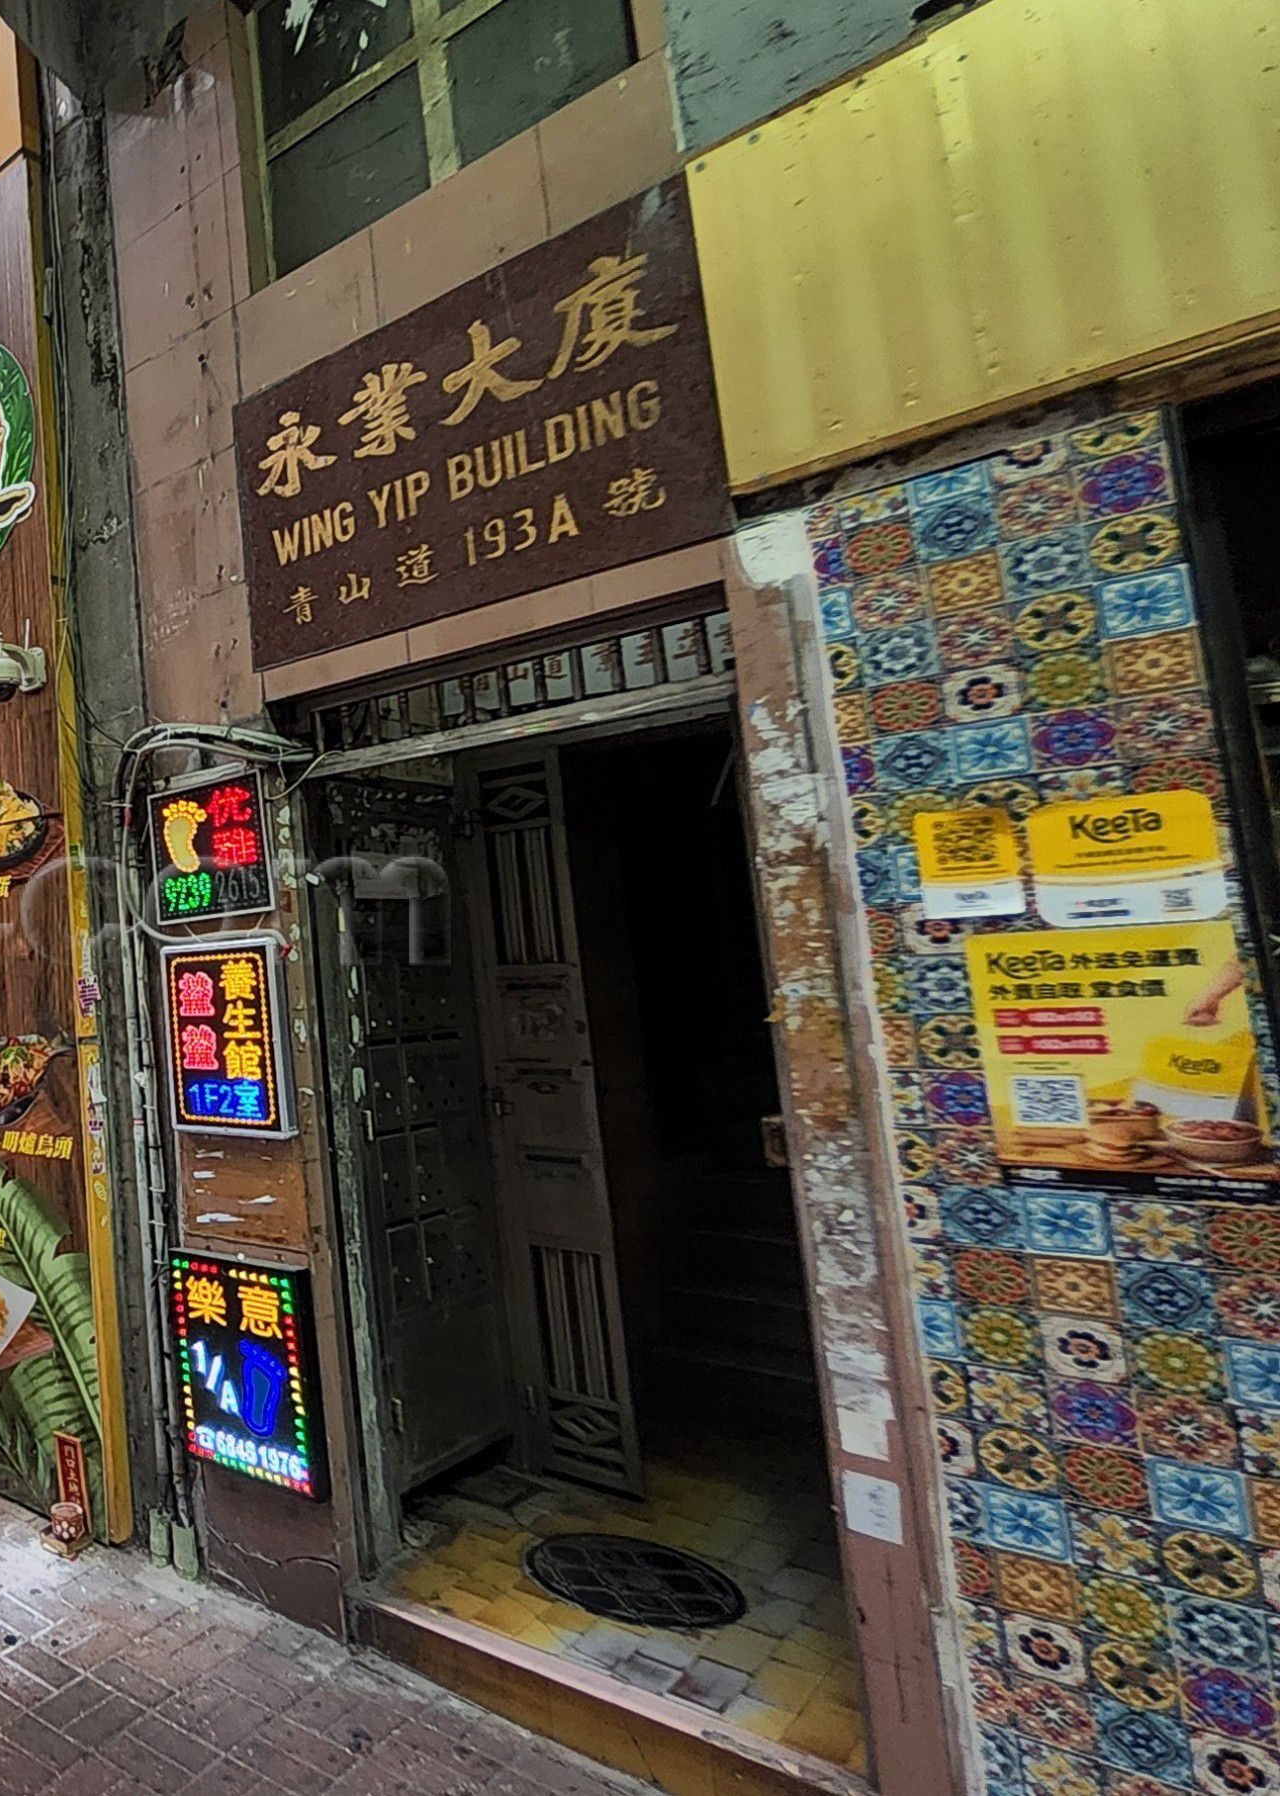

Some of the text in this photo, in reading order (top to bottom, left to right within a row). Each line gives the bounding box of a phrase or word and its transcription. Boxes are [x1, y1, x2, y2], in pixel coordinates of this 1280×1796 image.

[256, 253, 679, 499] 永業大廈
[272, 380, 661, 567] WING YIP BUILDING
[282, 468, 668, 625] 青山道 193A 號
[215, 864, 261, 903] 2615
[1068, 808, 1162, 843] KeeTa
[219, 960, 262, 1080] 養生館
